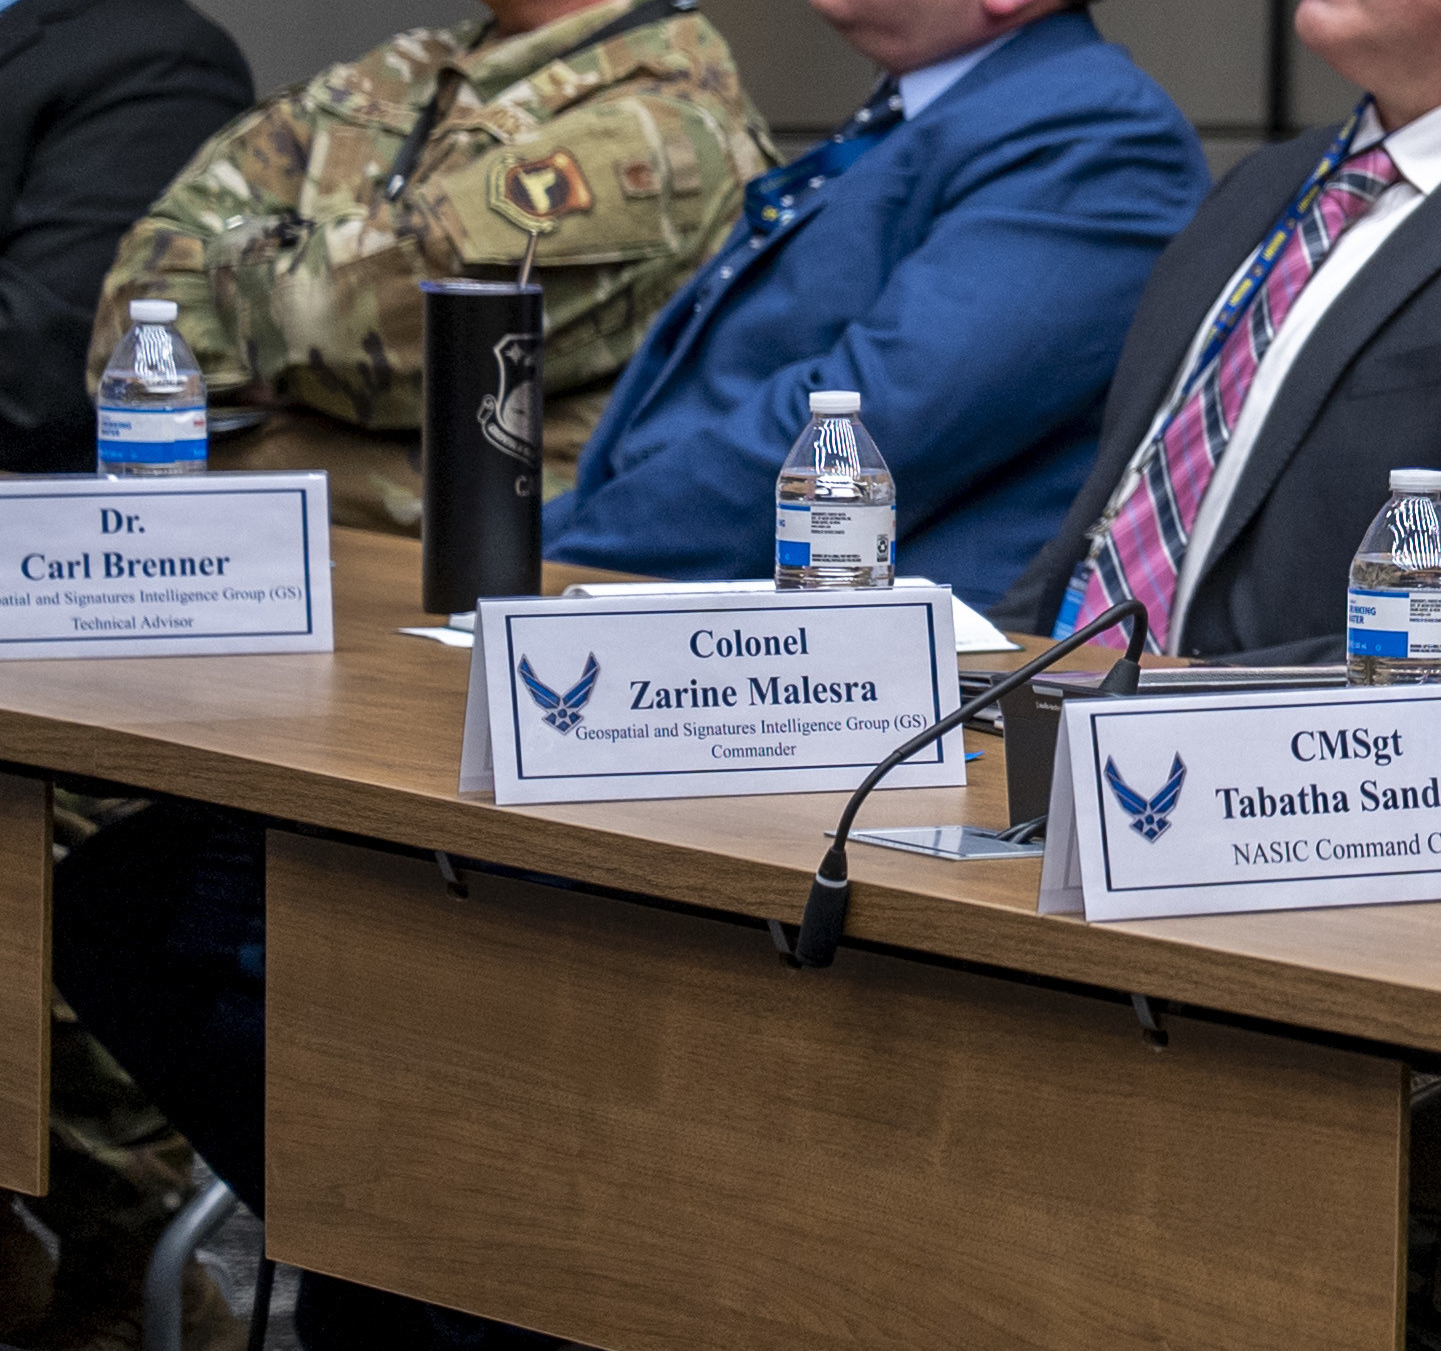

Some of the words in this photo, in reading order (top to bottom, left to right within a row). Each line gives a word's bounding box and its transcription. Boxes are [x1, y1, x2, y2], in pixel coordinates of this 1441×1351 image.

[100, 508, 145, 535] Dr.
[21, 551, 91, 581] Carl
[103, 551, 231, 580] Brenner
[36, 591, 59, 606] and
[64, 590, 135, 609] Signatures
[140, 588, 218, 606] Intelligence
[223, 586, 265, 604] Group
[270, 585, 302, 601] (GS)
[72, 617, 136, 632] Technical
[141, 615, 194, 630] Advisor
[690, 627, 810, 659] Colonel
[629, 678, 738, 711] Zarine
[749, 675, 878, 707] Malesra
[575, 724, 650, 744] Geospatial
[654, 722, 679, 739] and
[683, 720, 756, 740] Signatures
[760, 717, 841, 738] Intelligence
[847, 715, 889, 734] Group
[893, 713, 928, 732] (GS)
[711, 740, 797, 760] Commander
[1290, 728, 1404, 766] CMSgt
[1215, 783, 1350, 820] Tabatha
[1232, 839, 1310, 866] NASIC
[1315, 833, 1421, 862] Command
